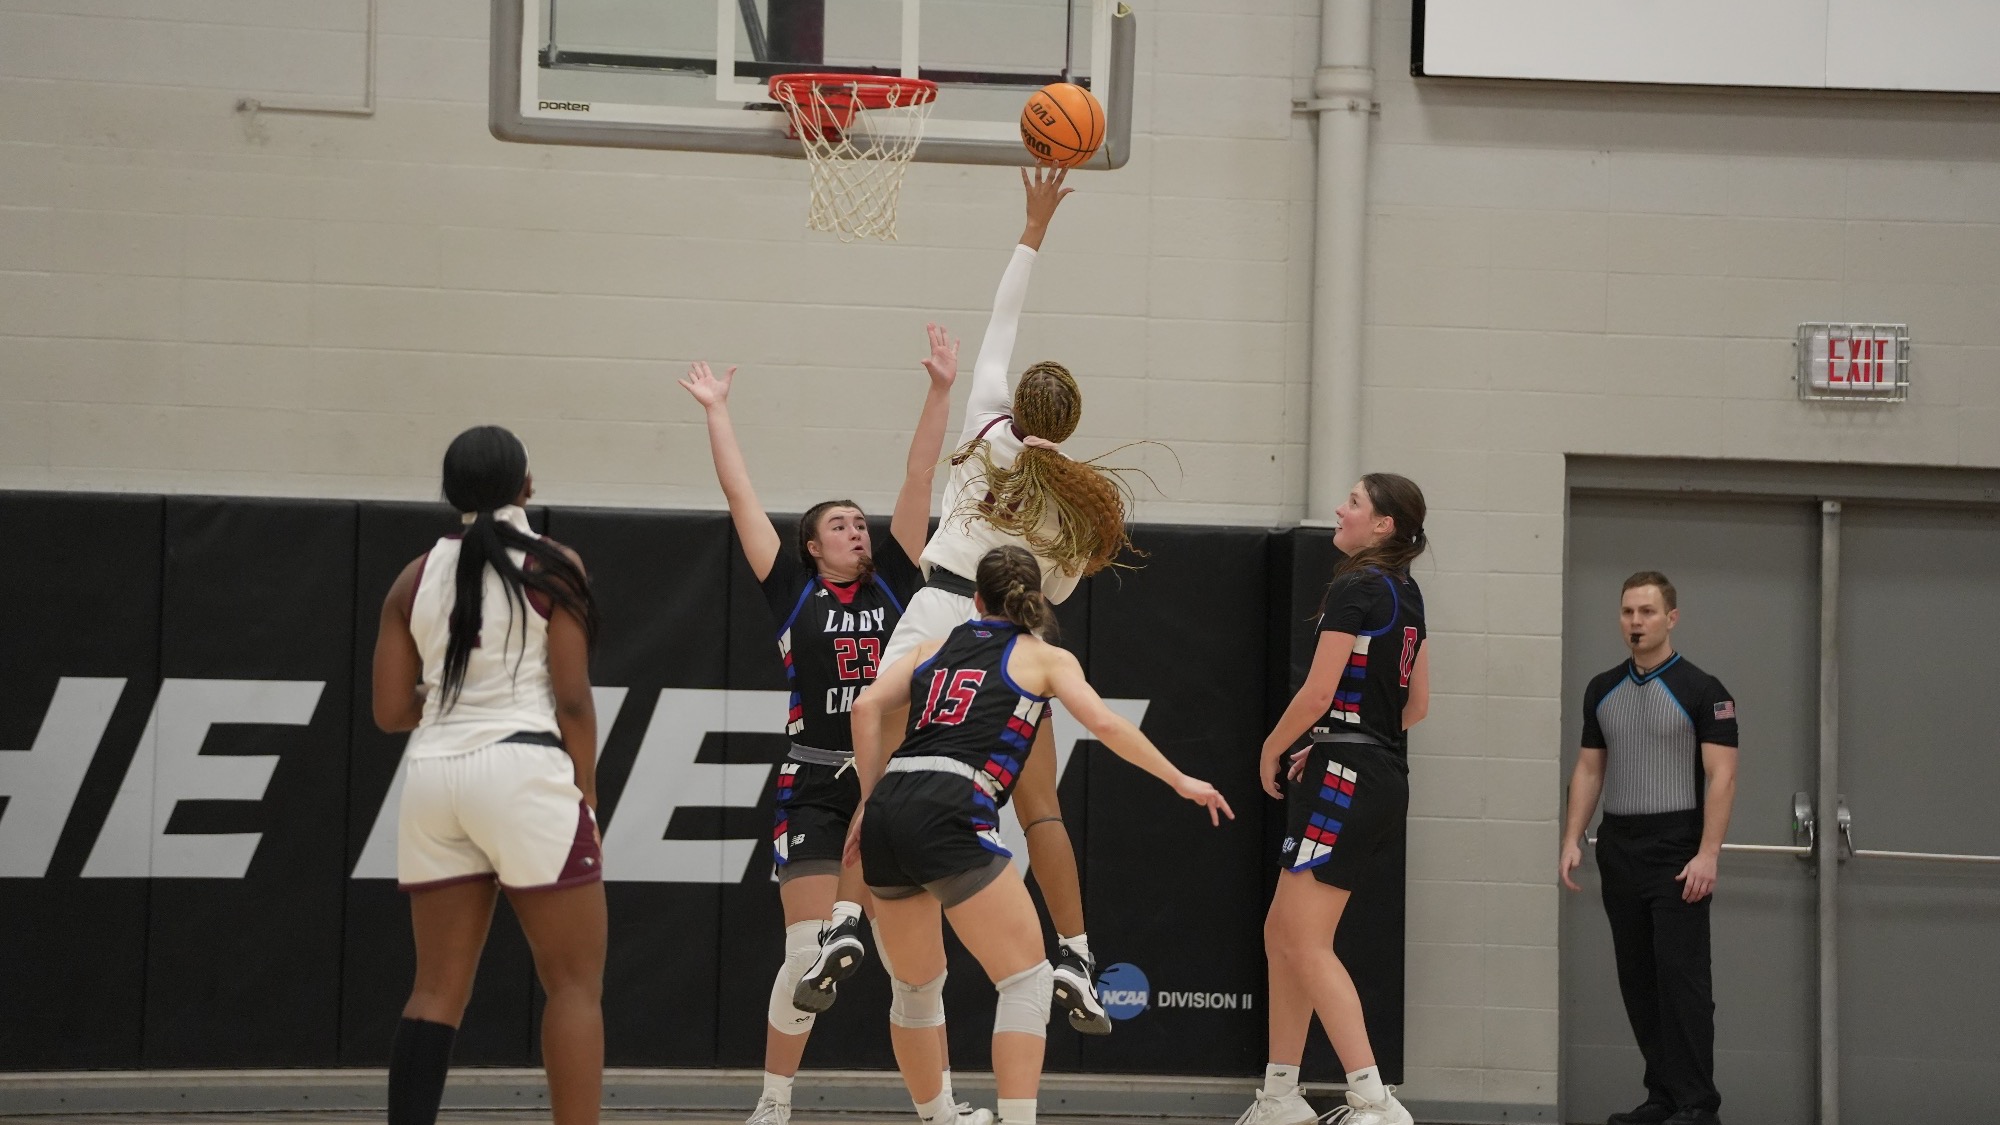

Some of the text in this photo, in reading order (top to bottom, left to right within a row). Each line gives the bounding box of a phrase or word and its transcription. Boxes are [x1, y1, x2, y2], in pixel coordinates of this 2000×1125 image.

[1828, 339, 1889, 382] EXIT
[823, 607, 885, 632] LADY
[834, 637, 881, 680] 23
[915, 668, 987, 730] 15
[1102, 990, 1147, 1006] NCAA
[1158, 991, 1252, 1009] DIVISION II
